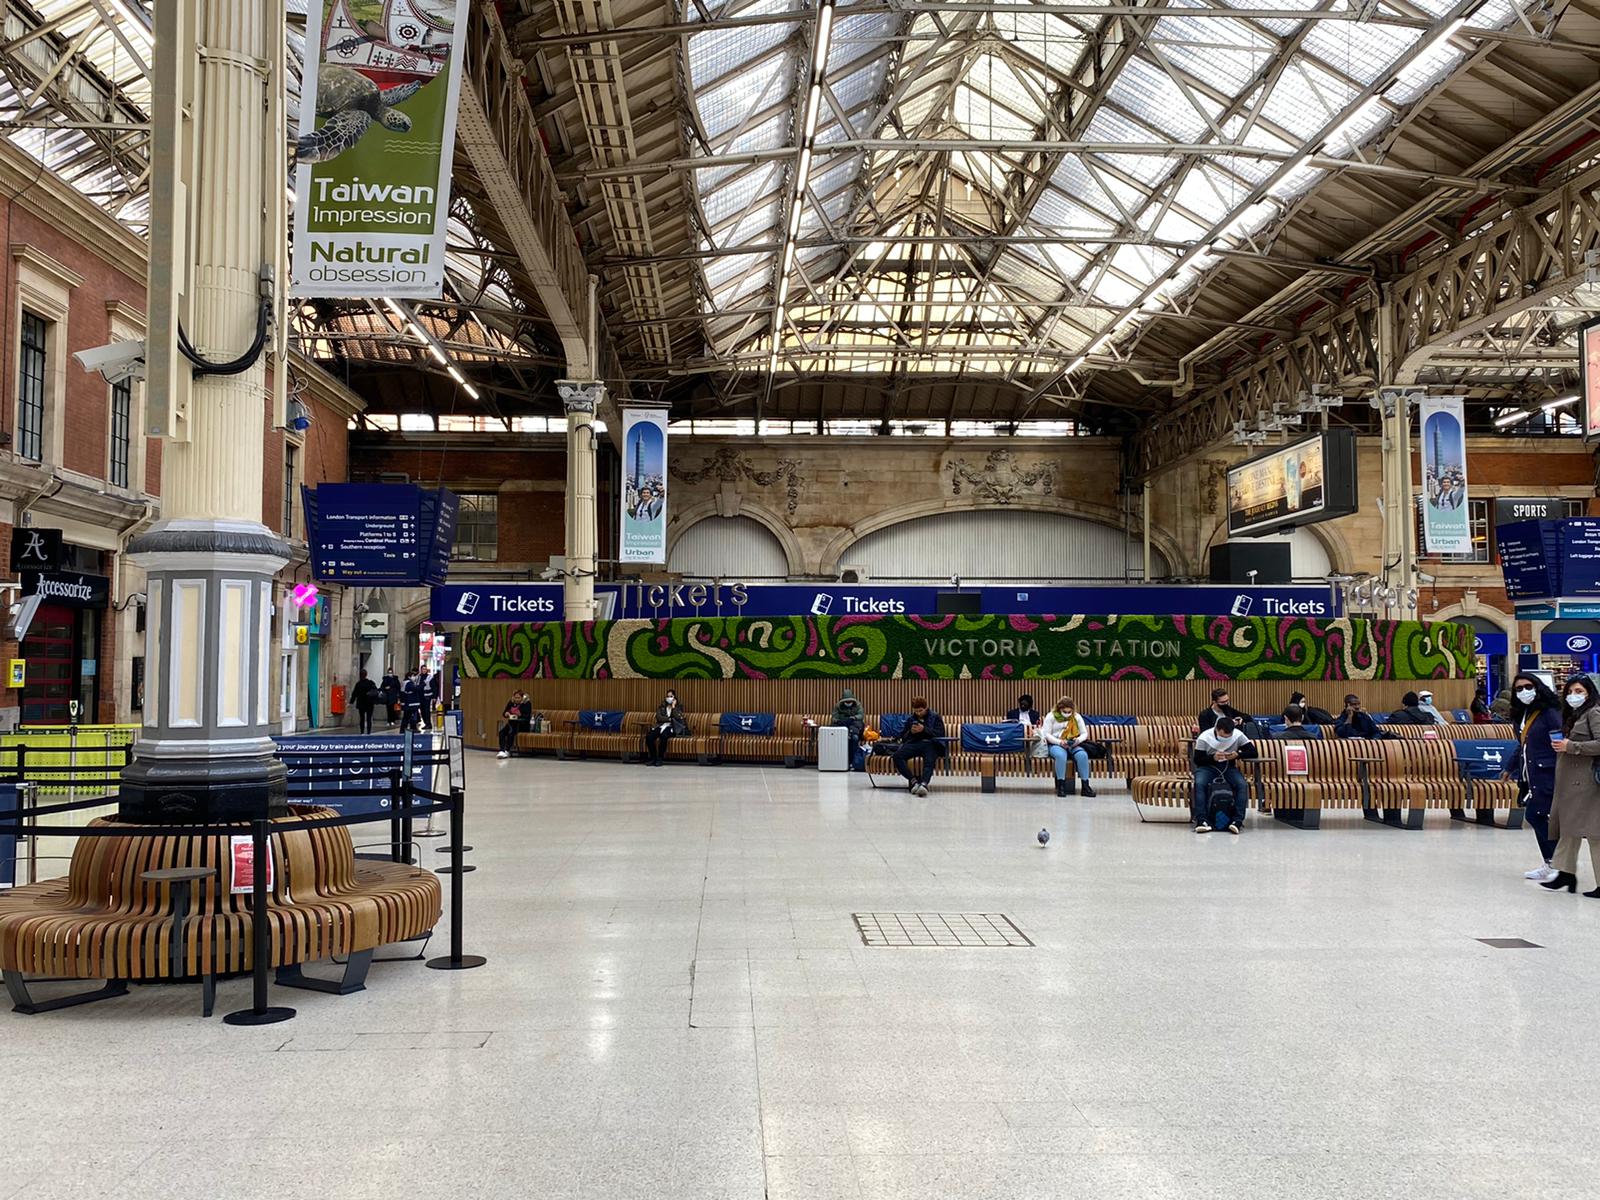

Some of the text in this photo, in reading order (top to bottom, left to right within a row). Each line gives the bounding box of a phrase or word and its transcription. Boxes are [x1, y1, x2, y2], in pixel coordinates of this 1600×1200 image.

[314, 177, 434, 204] Taiwan
[313, 206, 431, 226] Impression
[310, 241, 430, 264] Natural
[309, 265, 426, 282] obsession
[1513, 505, 1547, 517] SPORTS
[36, 573, 92, 601] Accessorize
[490, 595, 555, 612] Tickets
[842, 597, 905, 613] Tickets
[1262, 598, 1325, 614] Tickets
[924, 639, 1181, 658] VICTORIA STATION
